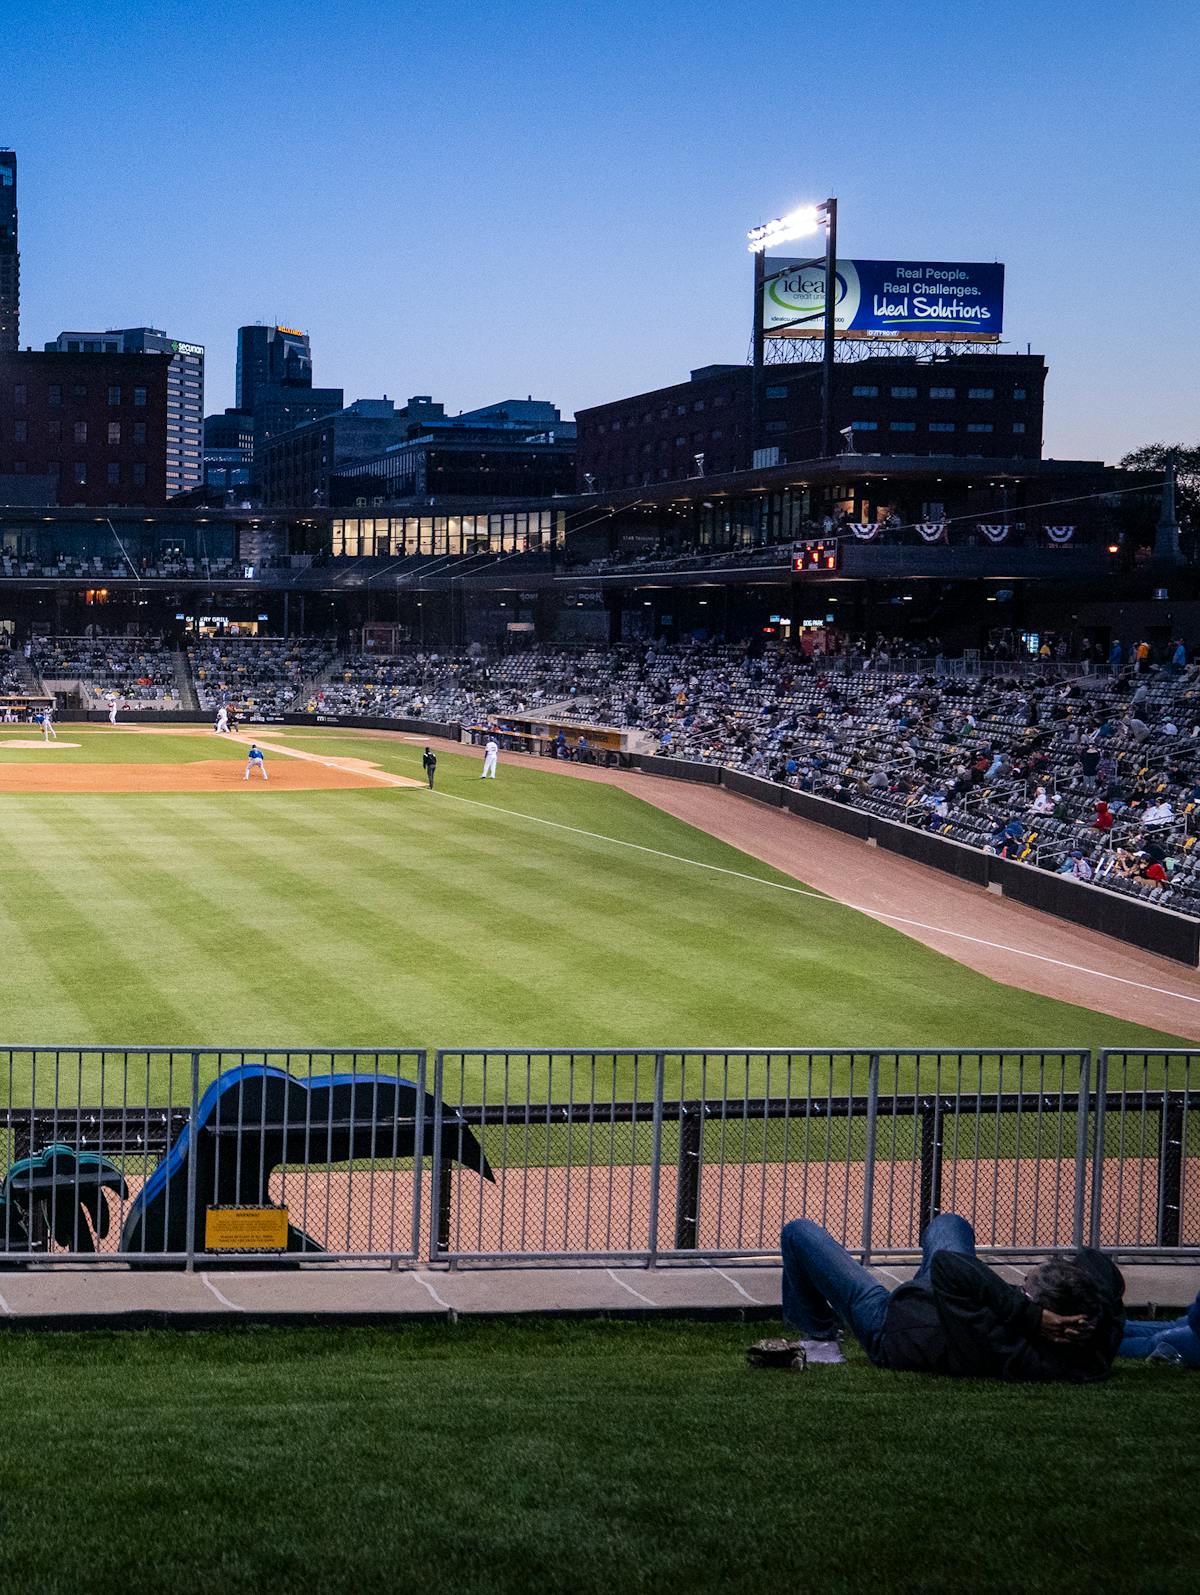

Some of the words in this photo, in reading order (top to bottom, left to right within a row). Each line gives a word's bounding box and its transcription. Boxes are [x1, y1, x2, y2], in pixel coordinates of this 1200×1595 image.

[896, 267, 922, 278] Real
[925, 268, 969, 281] People.
[783, 275, 826, 293] idea
[883, 282, 910, 294] Real
[912, 283, 982, 297] Challenges.
[873, 294, 908, 317] Ideal
[912, 296, 991, 319] Solutions
